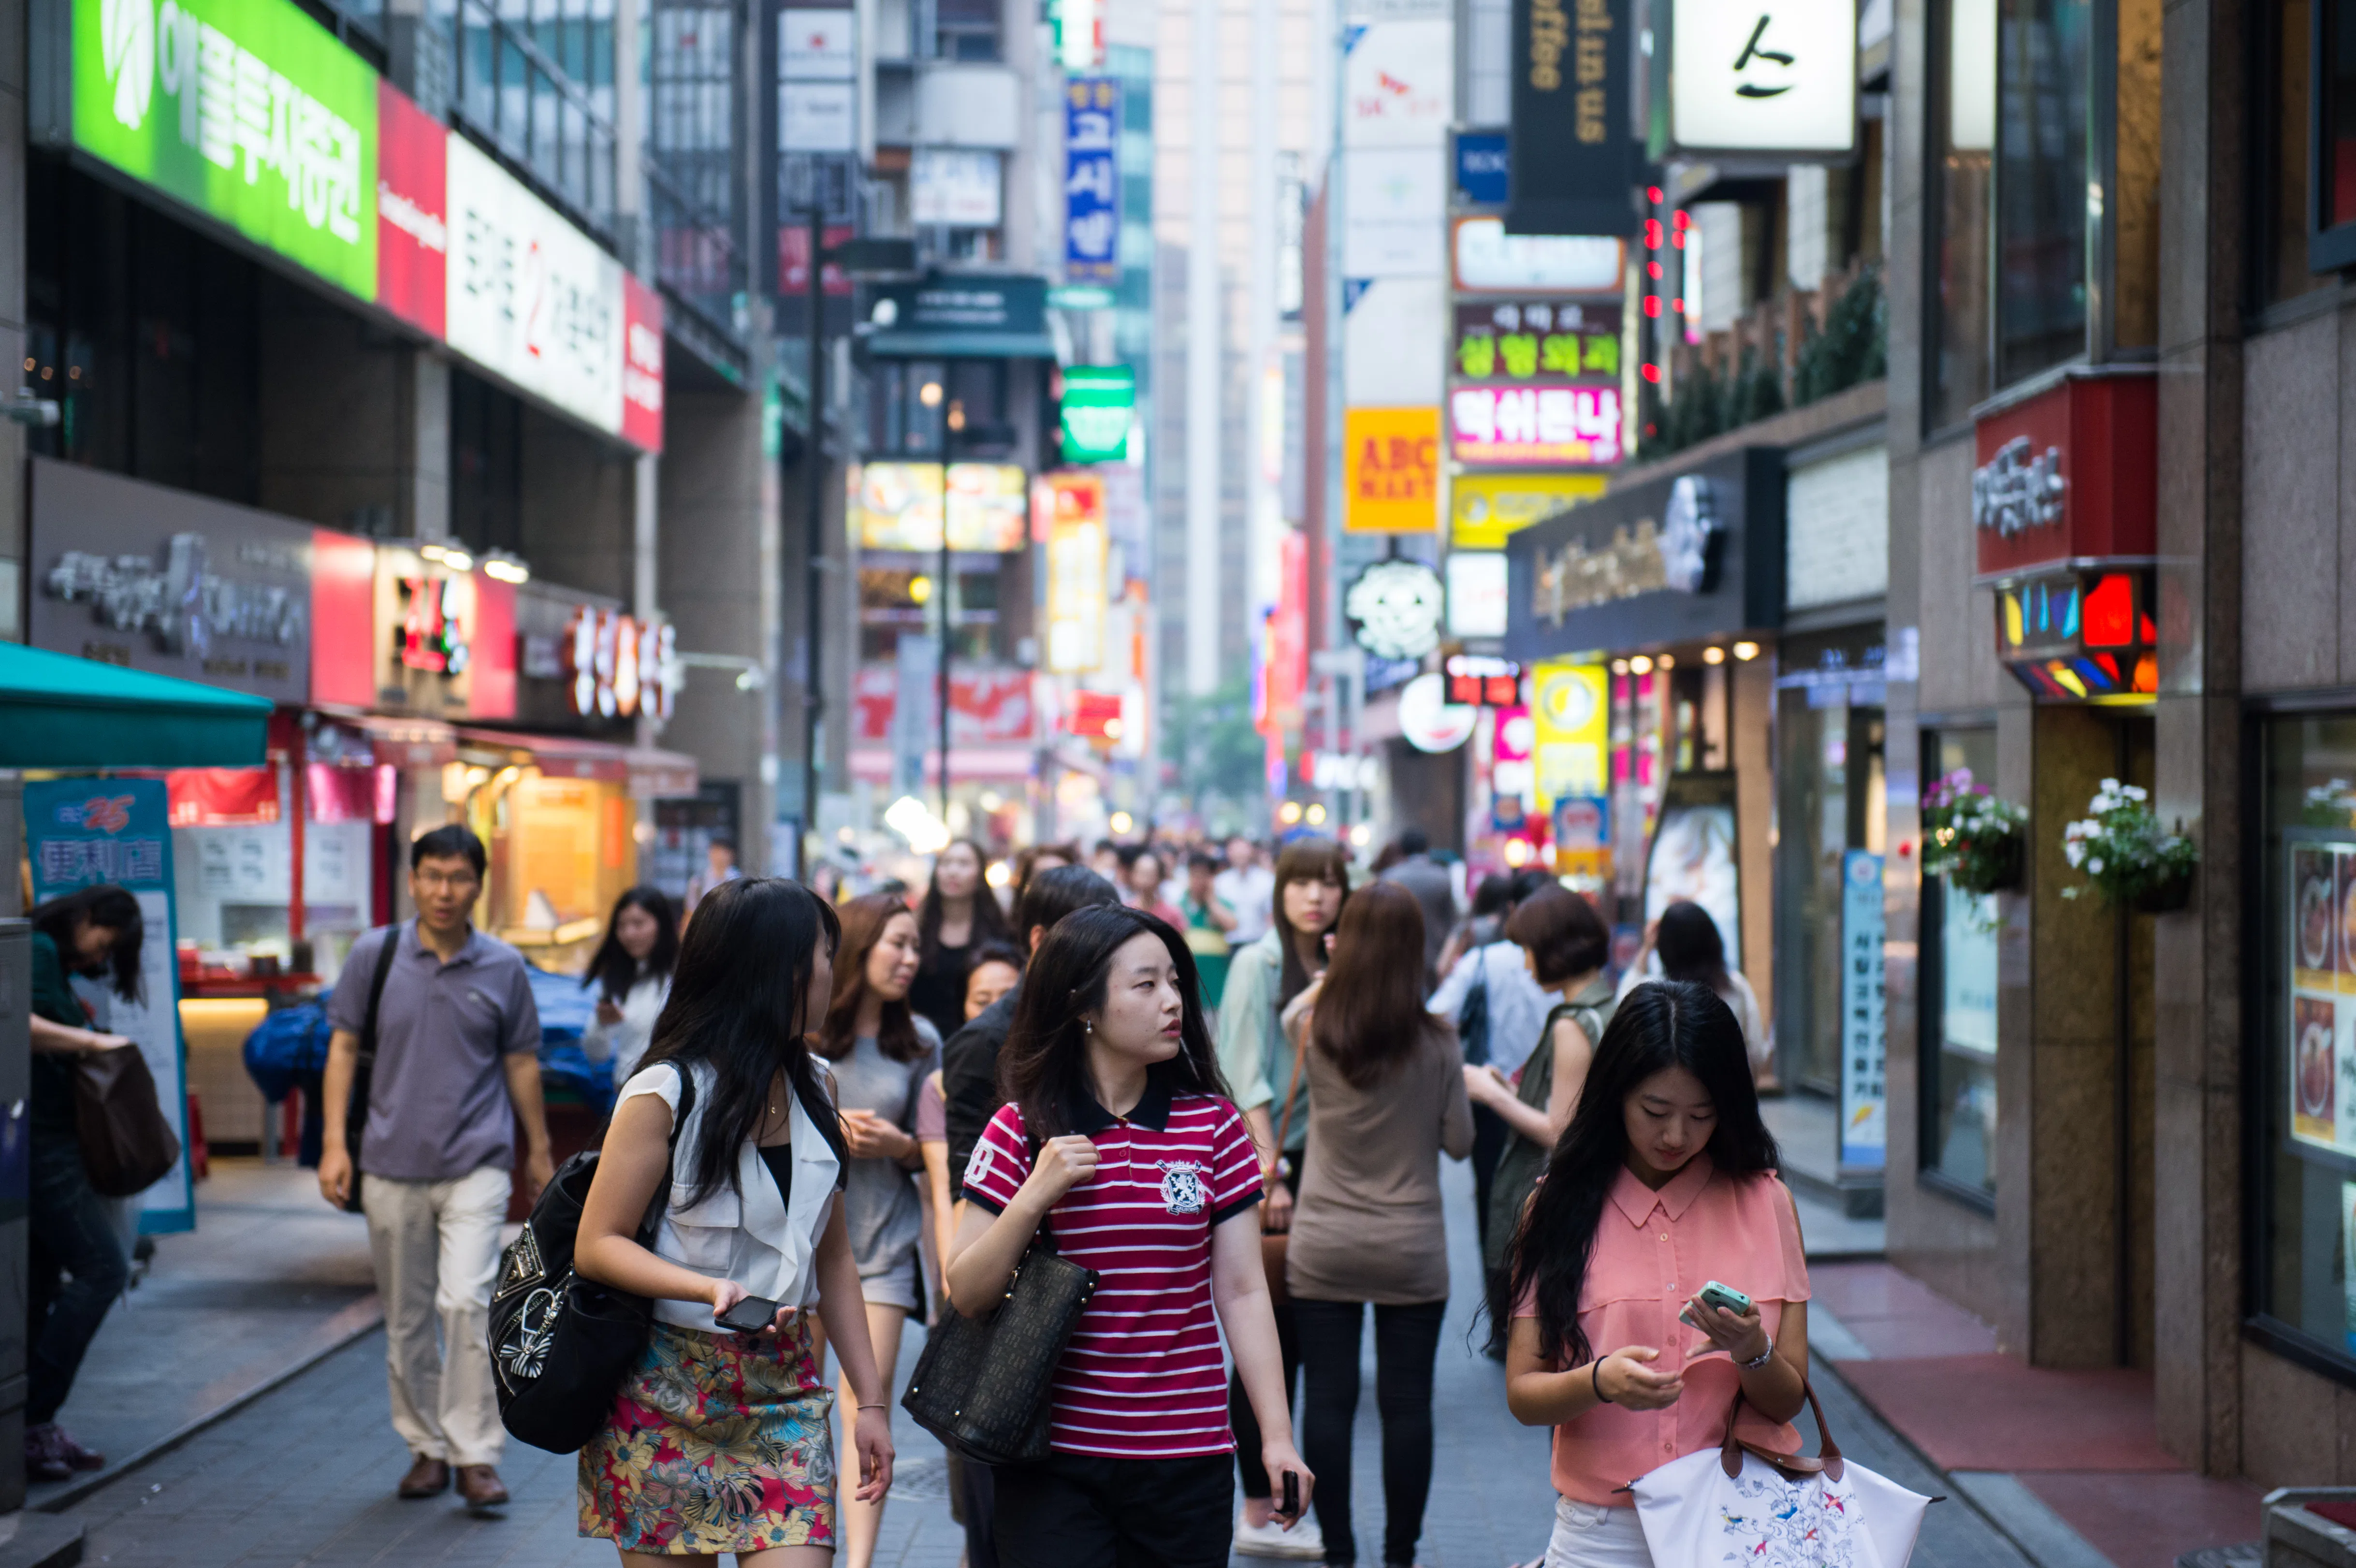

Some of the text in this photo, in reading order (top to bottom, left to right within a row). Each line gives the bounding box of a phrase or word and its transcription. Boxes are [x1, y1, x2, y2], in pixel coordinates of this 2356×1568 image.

[1732, 14, 1796, 99] 스
[1360, 436, 1439, 470] ABC
[38, 838, 164, 885] 便利店
